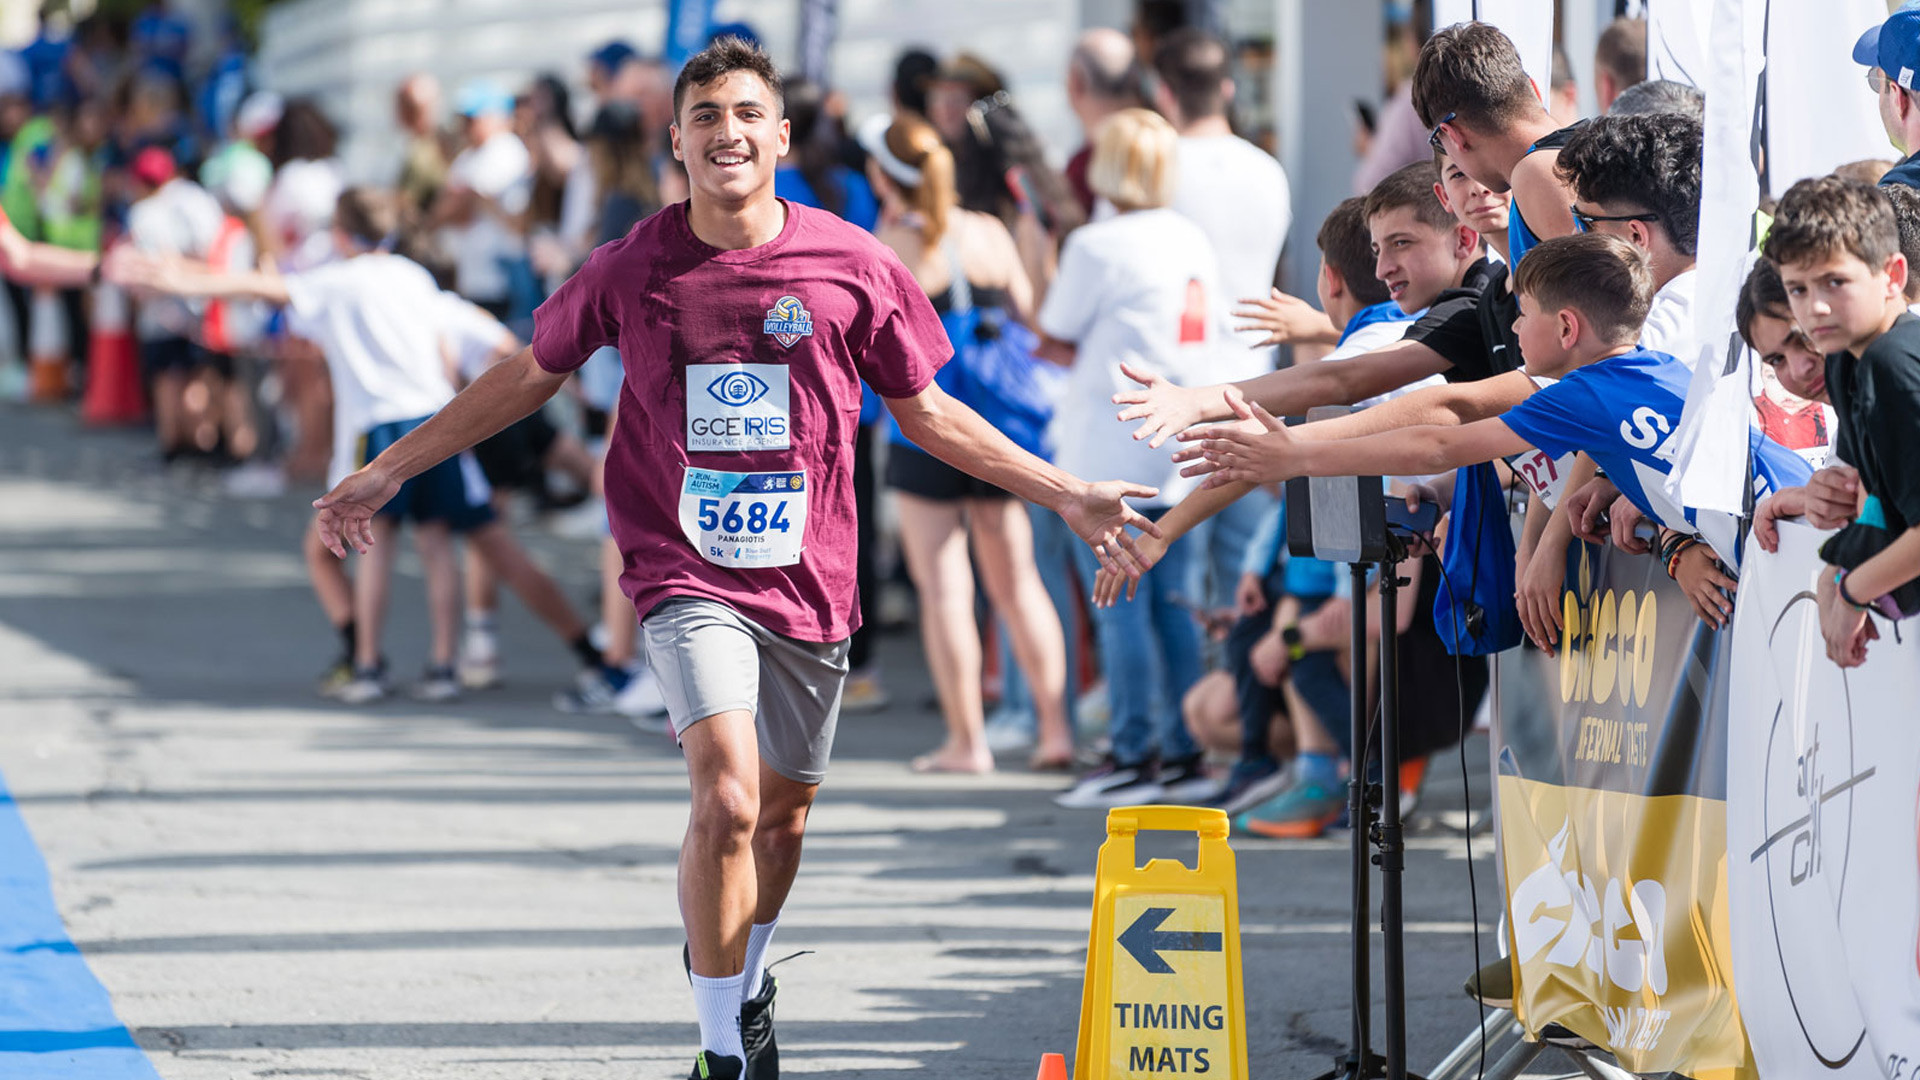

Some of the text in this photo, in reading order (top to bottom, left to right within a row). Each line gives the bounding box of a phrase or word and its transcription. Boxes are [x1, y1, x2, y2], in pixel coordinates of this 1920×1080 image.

[766, 321, 811, 333] VOLLEYBALL
[691, 416, 786, 437] GCE IRIS
[691, 437, 785, 447] INSURANCE AGENCY
[695, 472, 711, 482] RUN
[691, 480, 720, 490] AUTISM
[697, 498, 791, 535] 5684
[717, 534, 766, 544] PANAGIOTIS
[1114, 1002, 1224, 1030] TIMING
[1129, 1046, 1210, 1074] MATS
